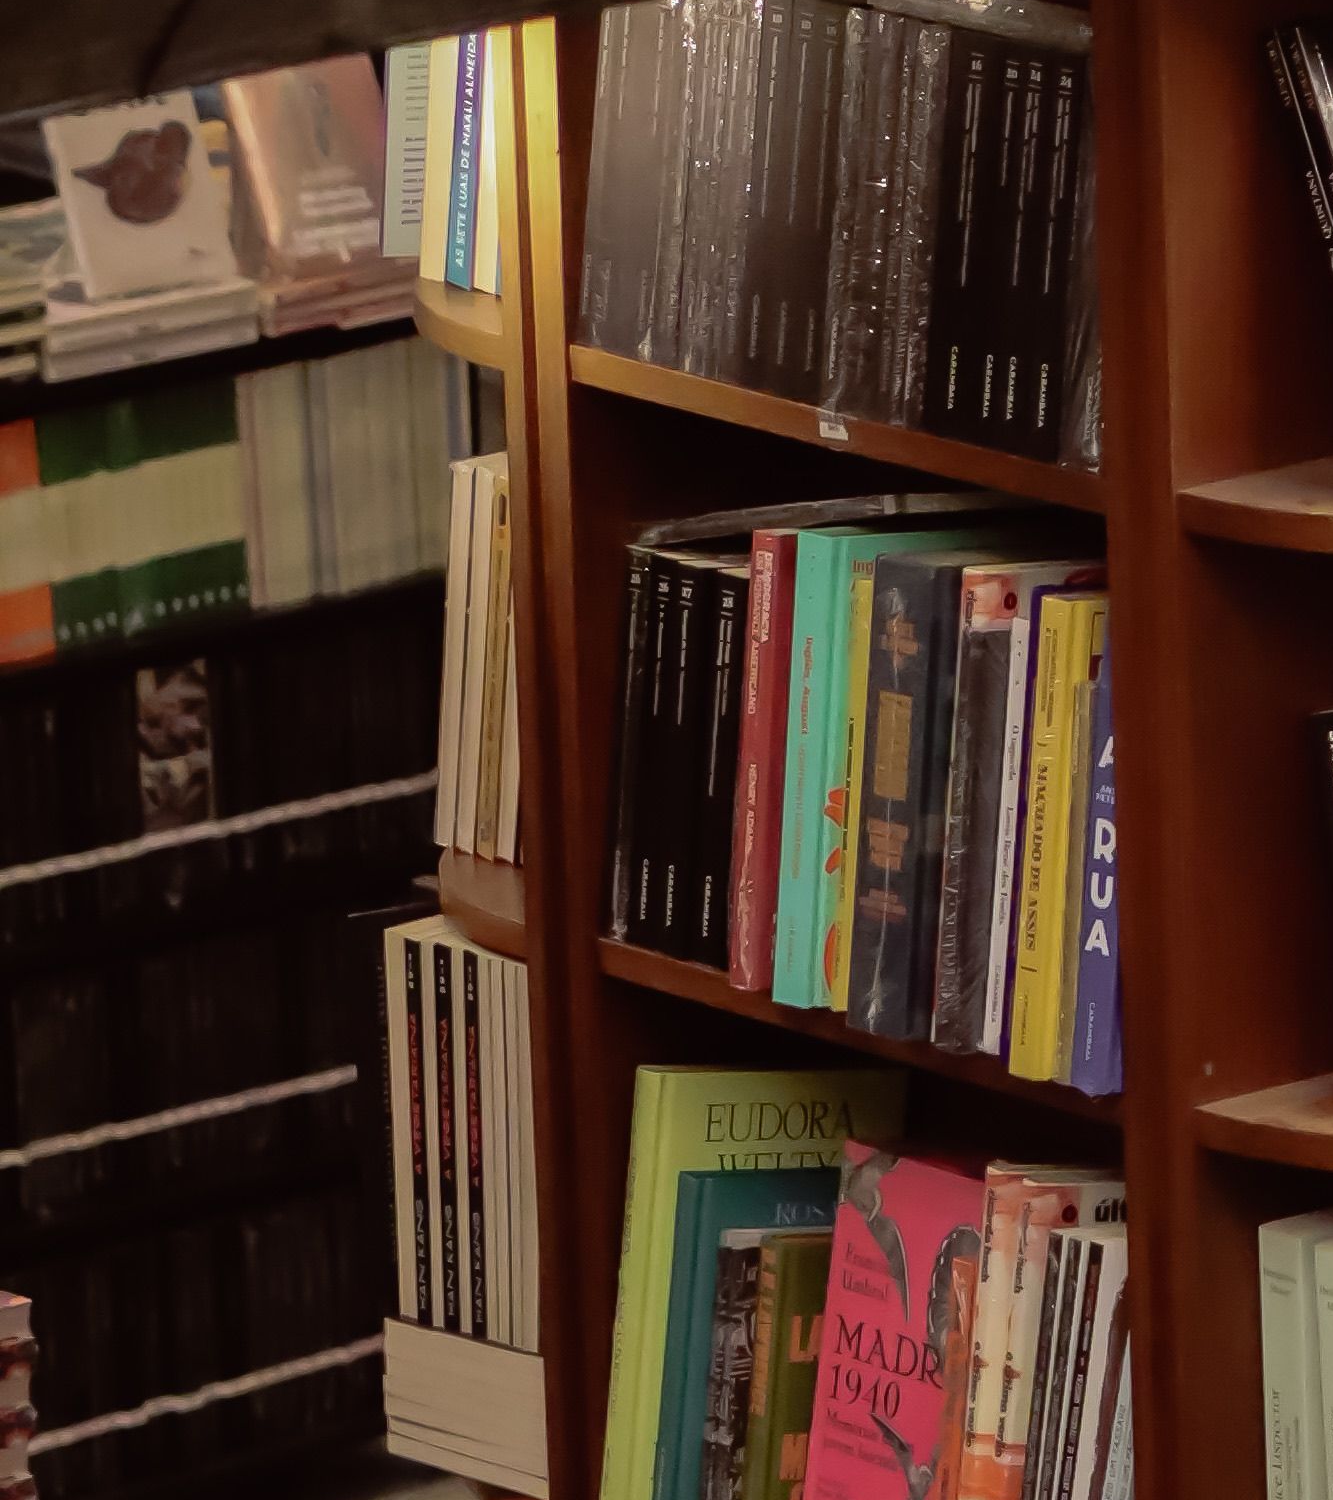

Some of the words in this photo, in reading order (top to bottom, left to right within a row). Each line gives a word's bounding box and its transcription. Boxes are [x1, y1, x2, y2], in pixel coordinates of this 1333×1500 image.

[465, 33, 477, 100] ALMEIDA
[460, 149, 470, 170] DE
[461, 173, 470, 209] LUAS
[456, 212, 468, 244] SETE
[704, 1101, 855, 1145] EUDORA
[836, 1315, 943, 1390] MADR
[829, 1363, 902, 1420] 1940
